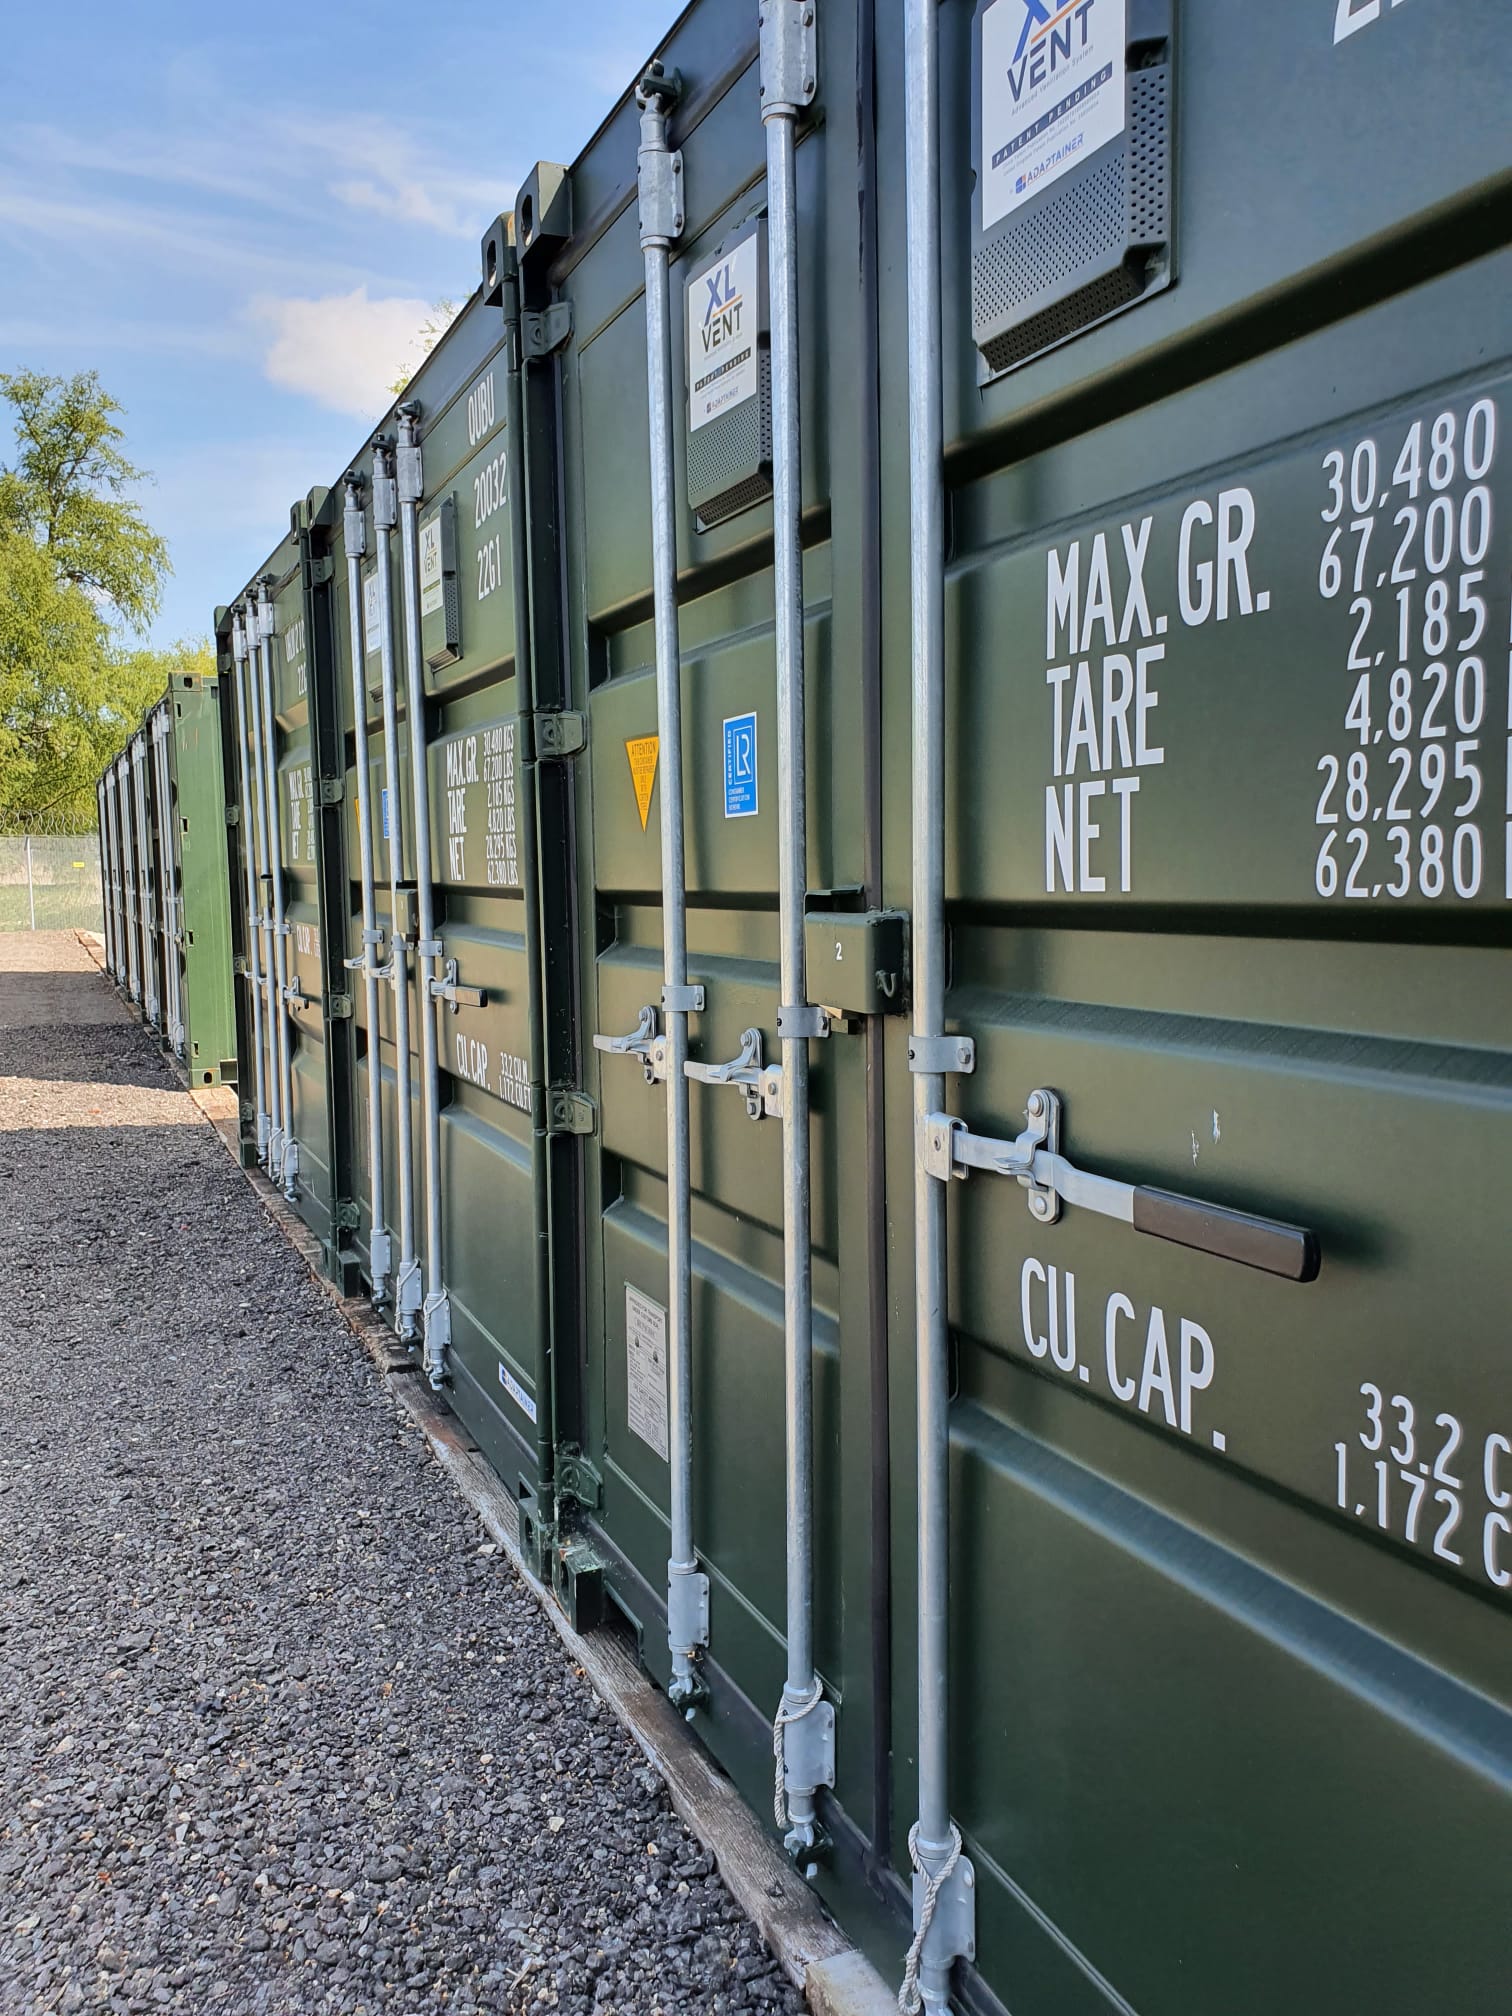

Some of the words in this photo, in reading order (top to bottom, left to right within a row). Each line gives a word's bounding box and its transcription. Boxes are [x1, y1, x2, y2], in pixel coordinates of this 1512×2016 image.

[1007, 0, 1095, 102] VENT
[995, 123, 1040, 164] PATENT
[1048, 70, 1109, 123] PENDING
[1027, 132, 1084, 182] ADAPTAINER
[701, 302, 744, 353] VENT
[704, 263, 737, 327] XL
[468, 371, 495, 446] QUBU
[474, 451, 507, 530] 20032
[1320, 398, 1496, 523] 30,480
[476, 533, 502, 601] 22G1
[1318, 485, 1491, 599] 67,200
[1046, 643, 1166, 778] TARE
[1346, 570, 1486, 671] 2,185
[1344, 656, 1485, 746] 4,820
[448, 787, 467, 834] TARE
[1045, 776, 1141, 893] NET
[1315, 739, 1482, 825] 28,295
[449, 837, 466, 881] NET
[1315, 822, 1482, 899] 62,380
[835, 941, 843, 961] 2
[1105, 1292, 1227, 1453] CAP.
[1358, 1382, 1463, 1489] 33.2
[1334, 1441, 1464, 1566] 1,172
